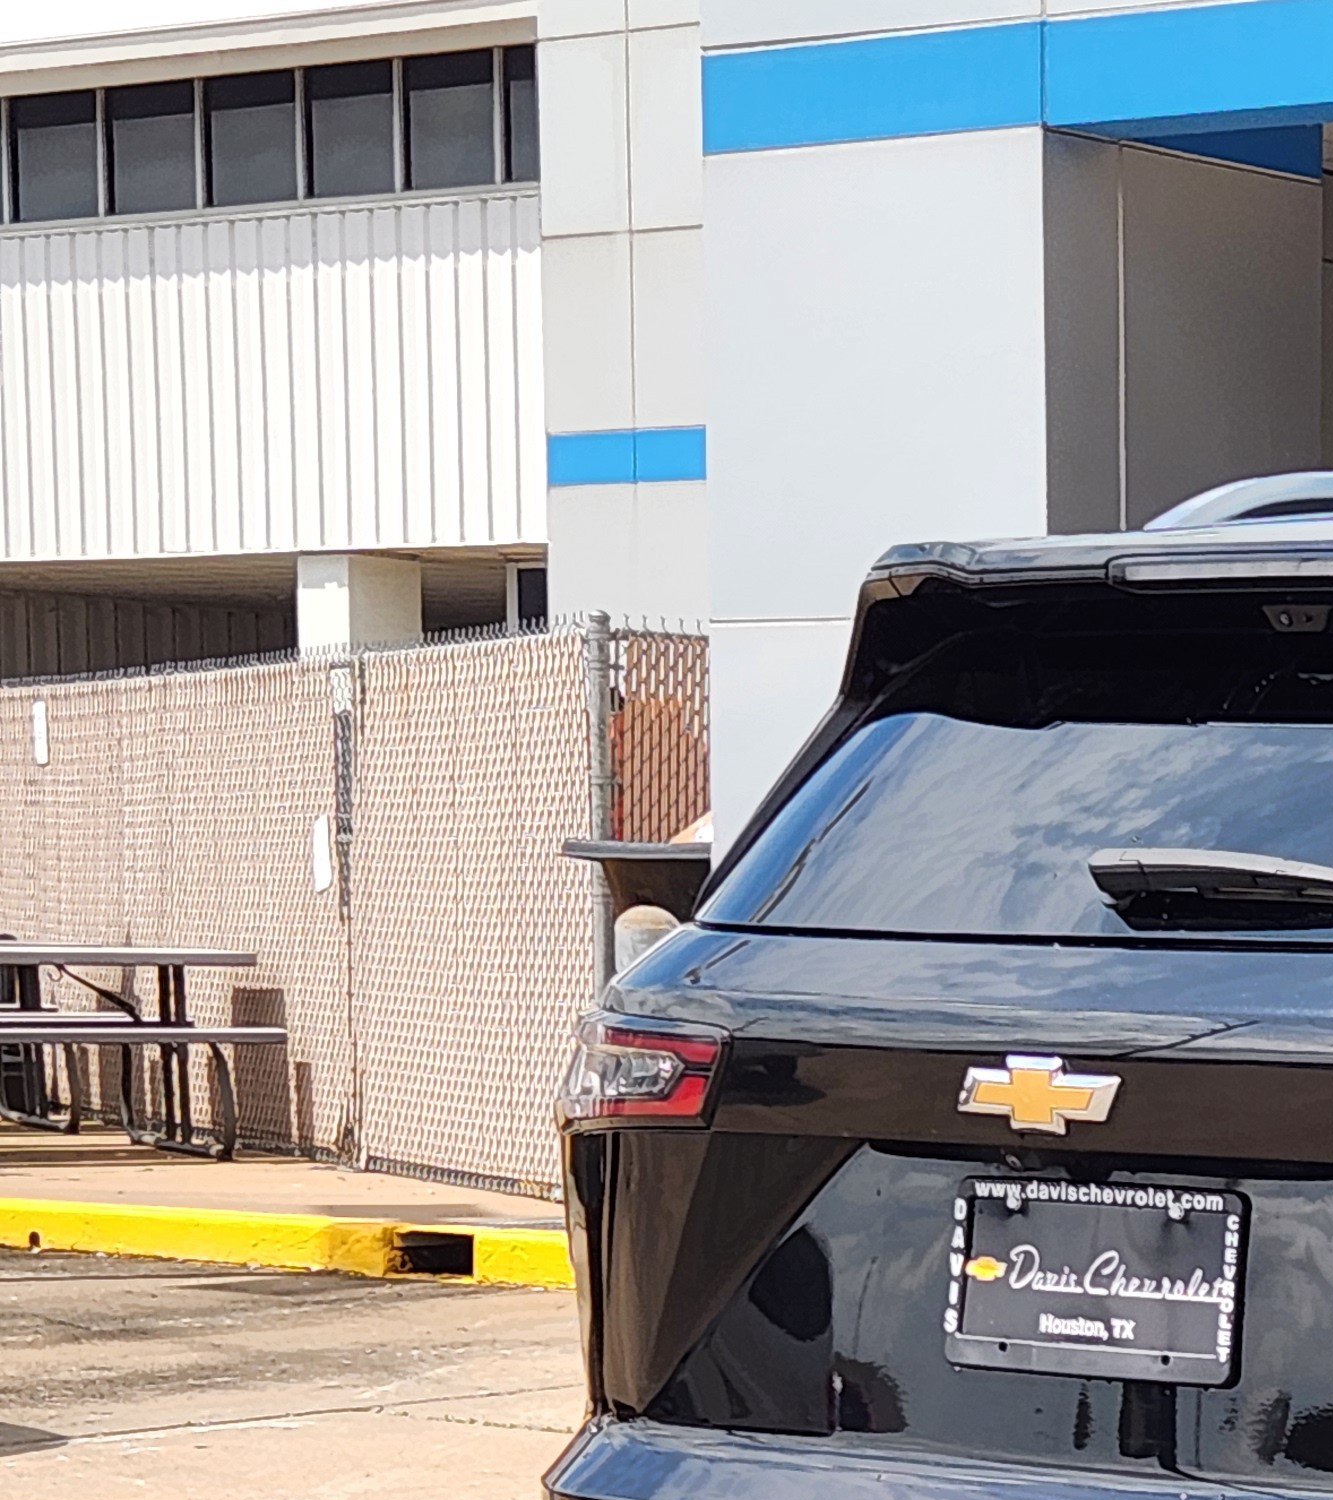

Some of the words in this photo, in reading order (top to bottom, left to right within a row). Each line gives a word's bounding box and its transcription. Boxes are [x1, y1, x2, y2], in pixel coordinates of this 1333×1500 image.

[944, 1197, 968, 1333] DAVIS
[1008, 1244, 1084, 1294] Davis
[1083, 1250, 1228, 1304] Chevrolet
[1216, 1214, 1240, 1363] CHEVROLET
[1038, 1312, 1109, 1341] Houston,
[1110, 1317, 1136, 1340] TX
